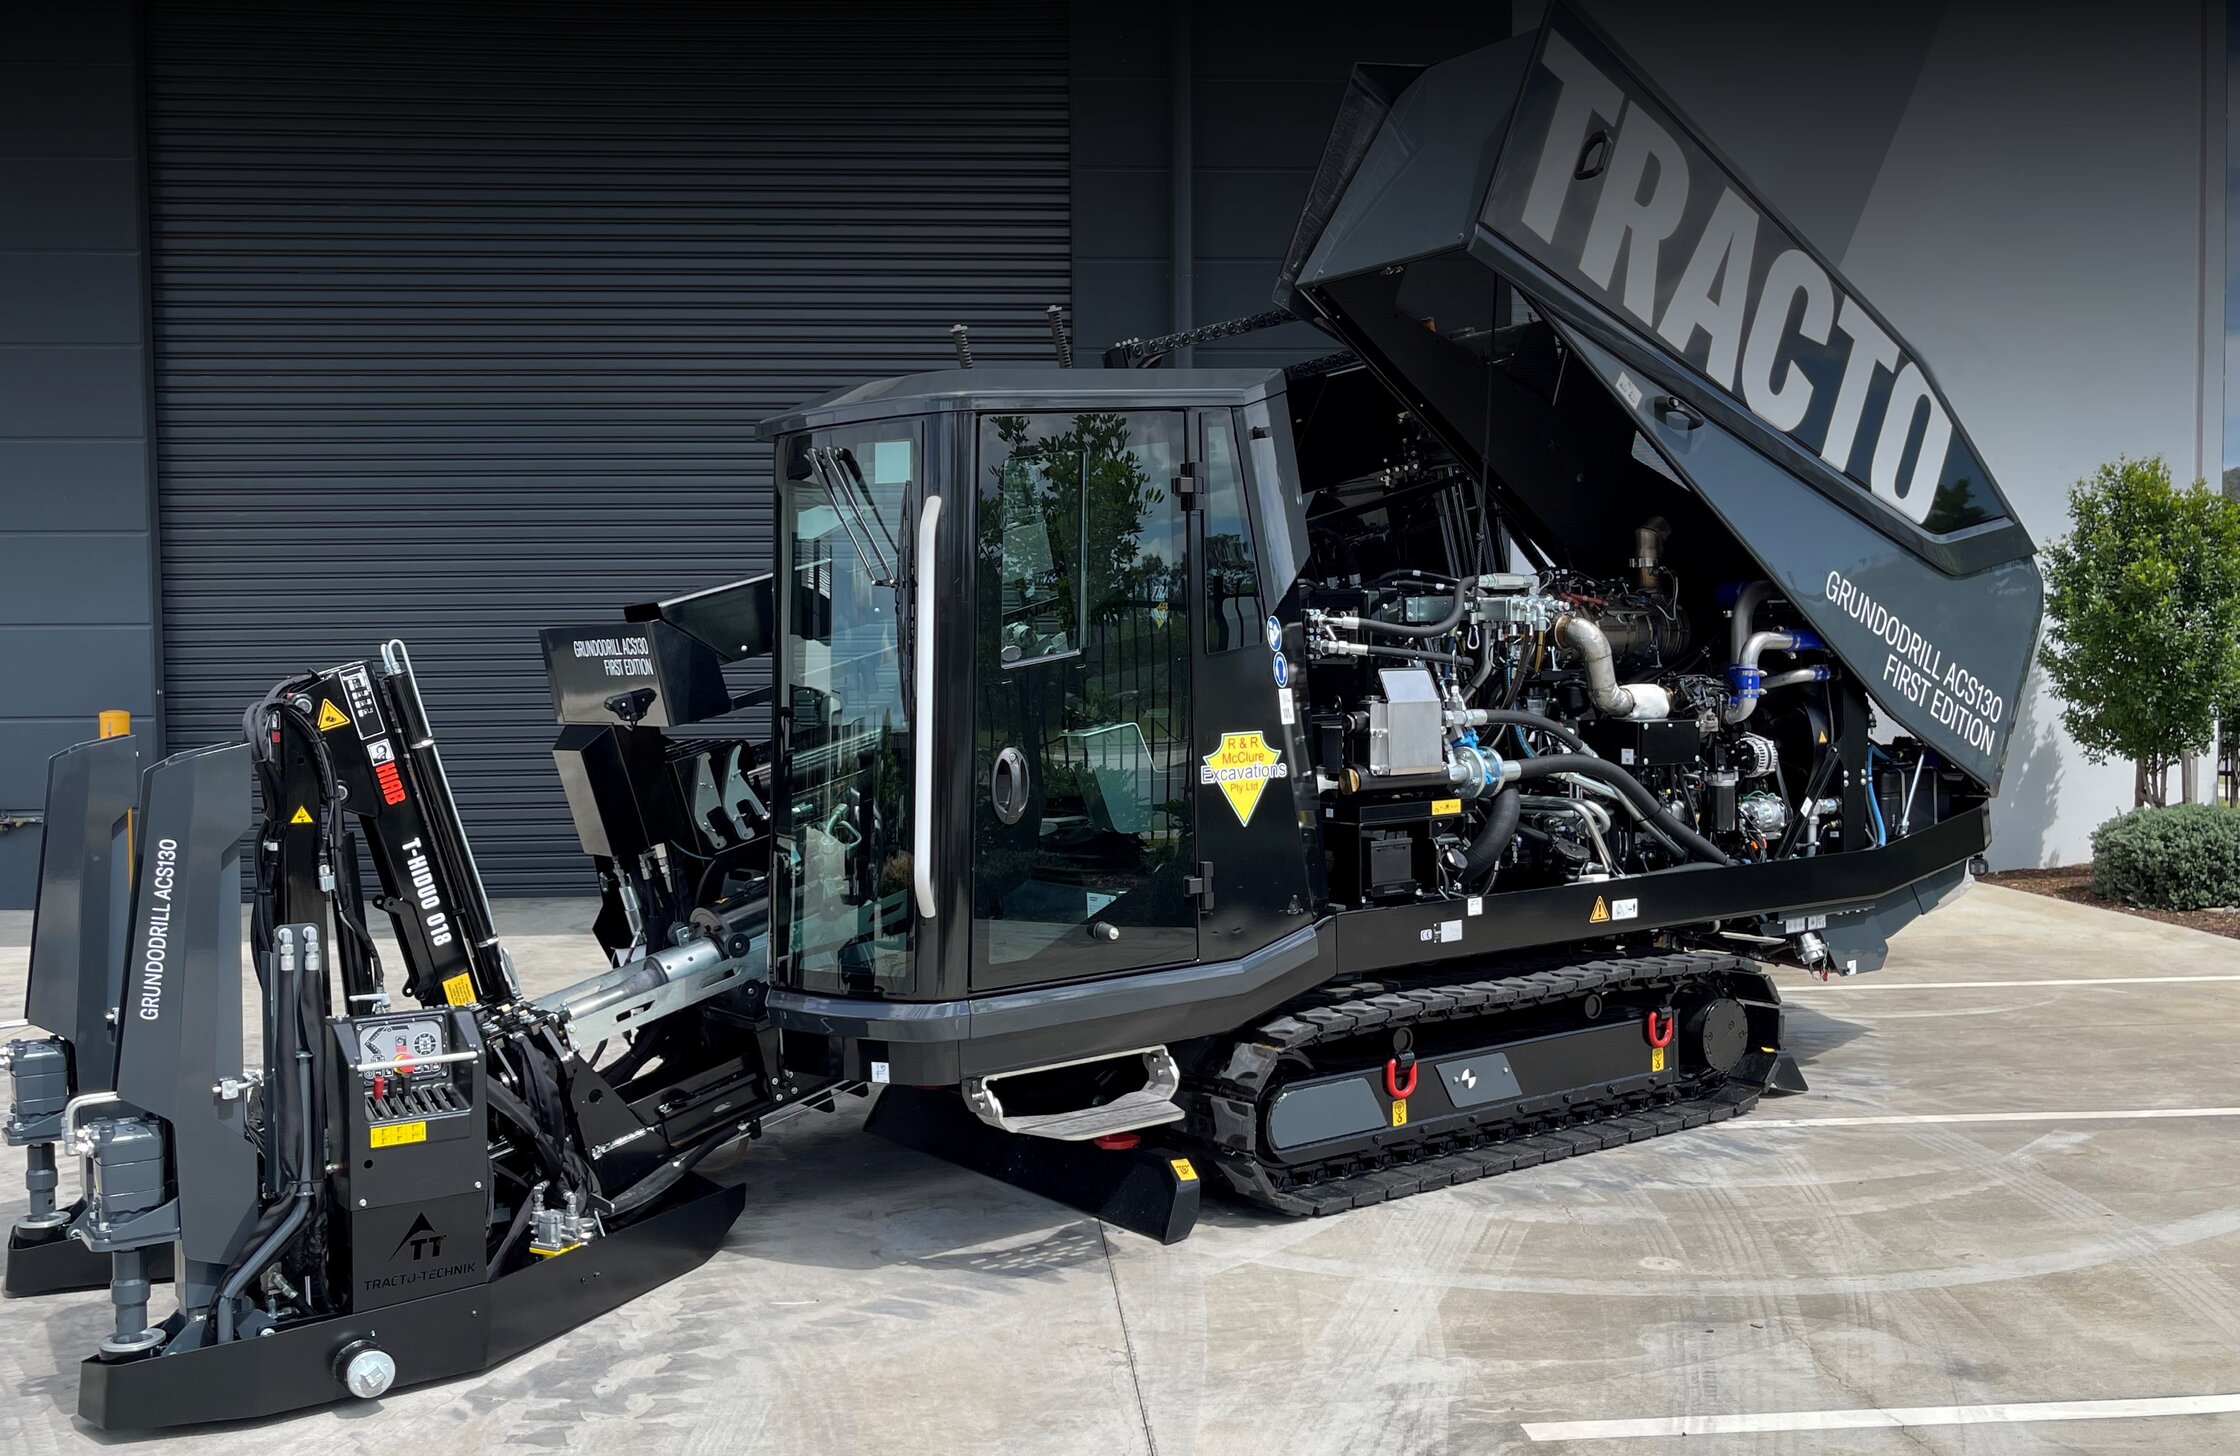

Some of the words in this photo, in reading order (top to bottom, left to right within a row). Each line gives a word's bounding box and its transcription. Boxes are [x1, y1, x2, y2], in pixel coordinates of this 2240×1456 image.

[1521, 28, 1953, 525] TRACTO
[573, 638, 622, 658] GRUNDODRILL
[622, 637, 649, 655] ACS130
[1826, 571, 1941, 681] GRUNDODRILL
[1943, 662, 2003, 723] ACS130
[604, 659, 623, 676] FIRST
[624, 658, 654, 675] EDITION
[1883, 653, 1932, 708] FIRST
[1930, 688, 1996, 756] EDITION
[1222, 751, 1264, 764] McClure
[1228, 738, 1236, 749] R
[1239, 737, 1247, 749] &
[1250, 736, 1258, 748] R
[375, 762, 406, 806] HIAB
[1202, 763, 1287, 783] Excavations
[1230, 783, 1243, 794] Pty
[1246, 782, 1259, 791] Ltd
[154, 838, 178, 900] ACS130
[402, 837, 441, 910] T-HIDUO
[427, 912, 452, 947] 018
[140, 903, 171, 1021] GRUNDODRILL
[364, 1263, 476, 1291] TRACTO-TECHNIK
